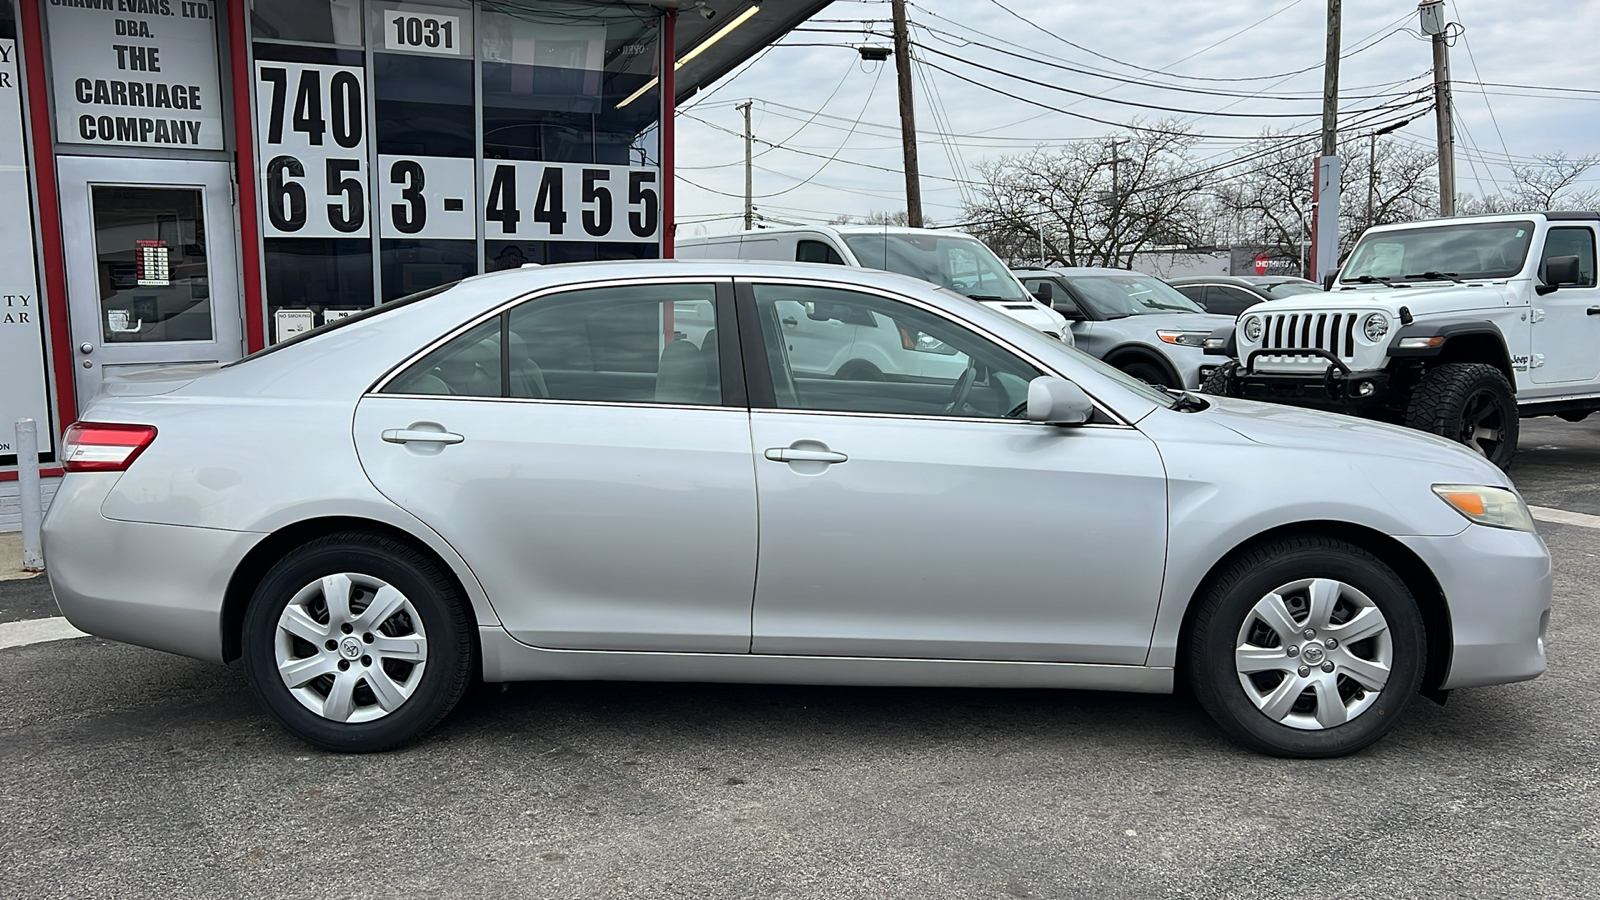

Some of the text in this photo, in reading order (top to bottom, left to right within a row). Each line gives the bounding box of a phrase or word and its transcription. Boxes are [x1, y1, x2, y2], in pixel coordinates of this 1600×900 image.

[118, 0, 175, 16] EVANS.
[181, 1, 213, 20] LTD.
[115, 18, 154, 38] DBA.
[392, 16, 453, 49] 1031
[113, 44, 161, 73] THE
[75, 78, 202, 110] CARRIAGE
[260, 67, 363, 149] 740
[79, 114, 202, 145] COMPANY
